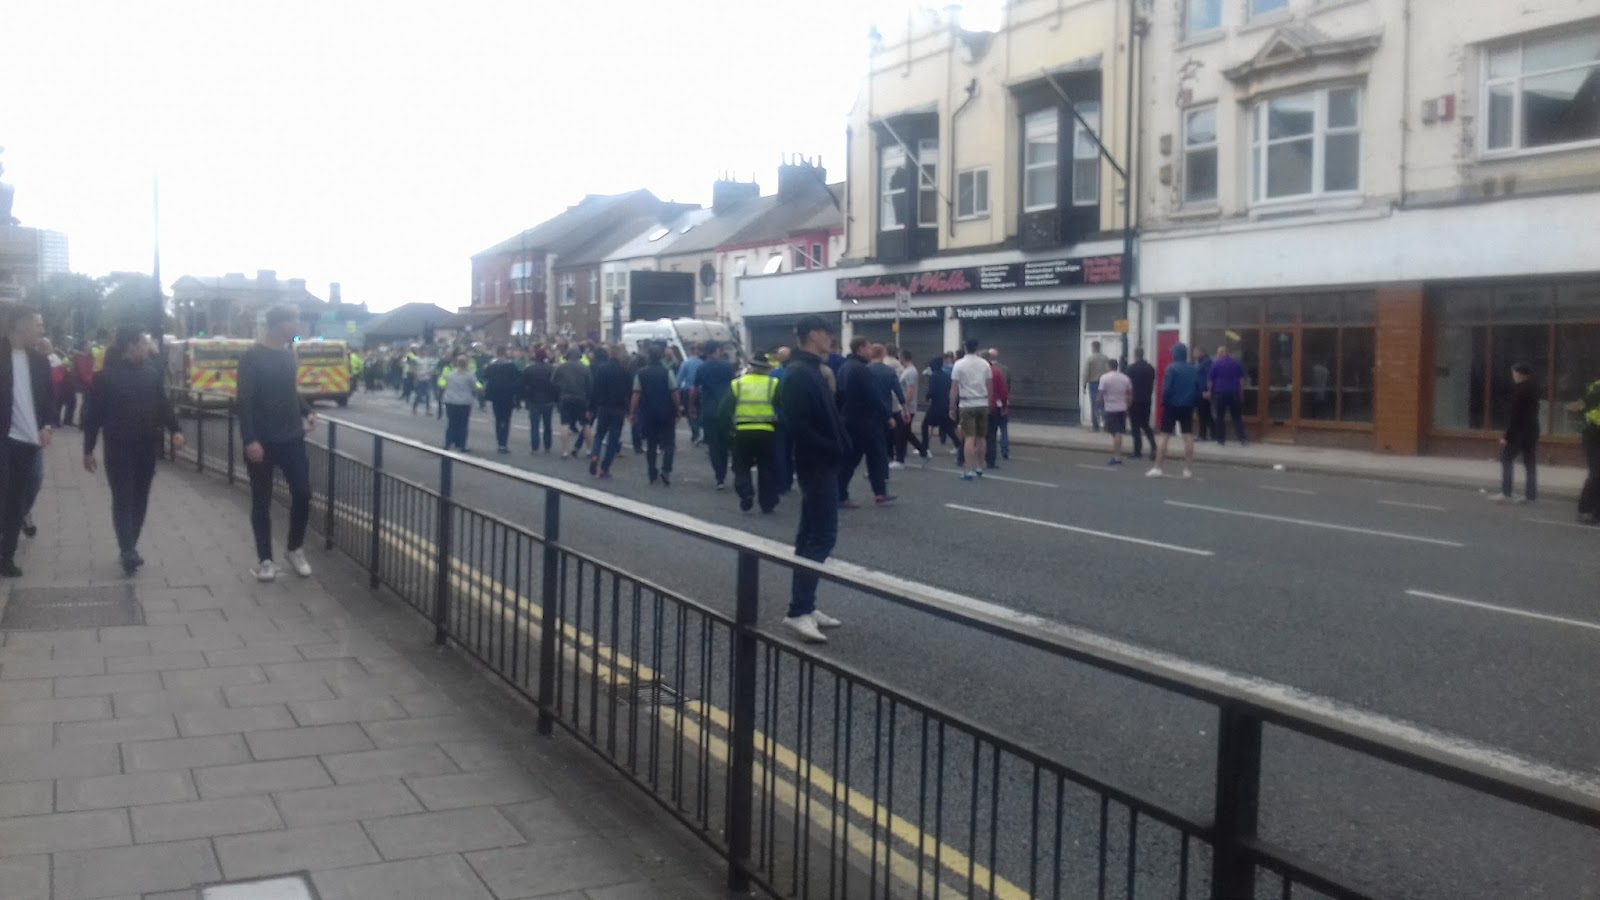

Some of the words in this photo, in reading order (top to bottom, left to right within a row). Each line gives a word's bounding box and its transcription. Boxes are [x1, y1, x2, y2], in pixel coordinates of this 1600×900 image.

[956, 308, 999, 319] Telephone
[1001, 306, 1021, 317] 0191
[1043, 303, 1069, 314] 4447
